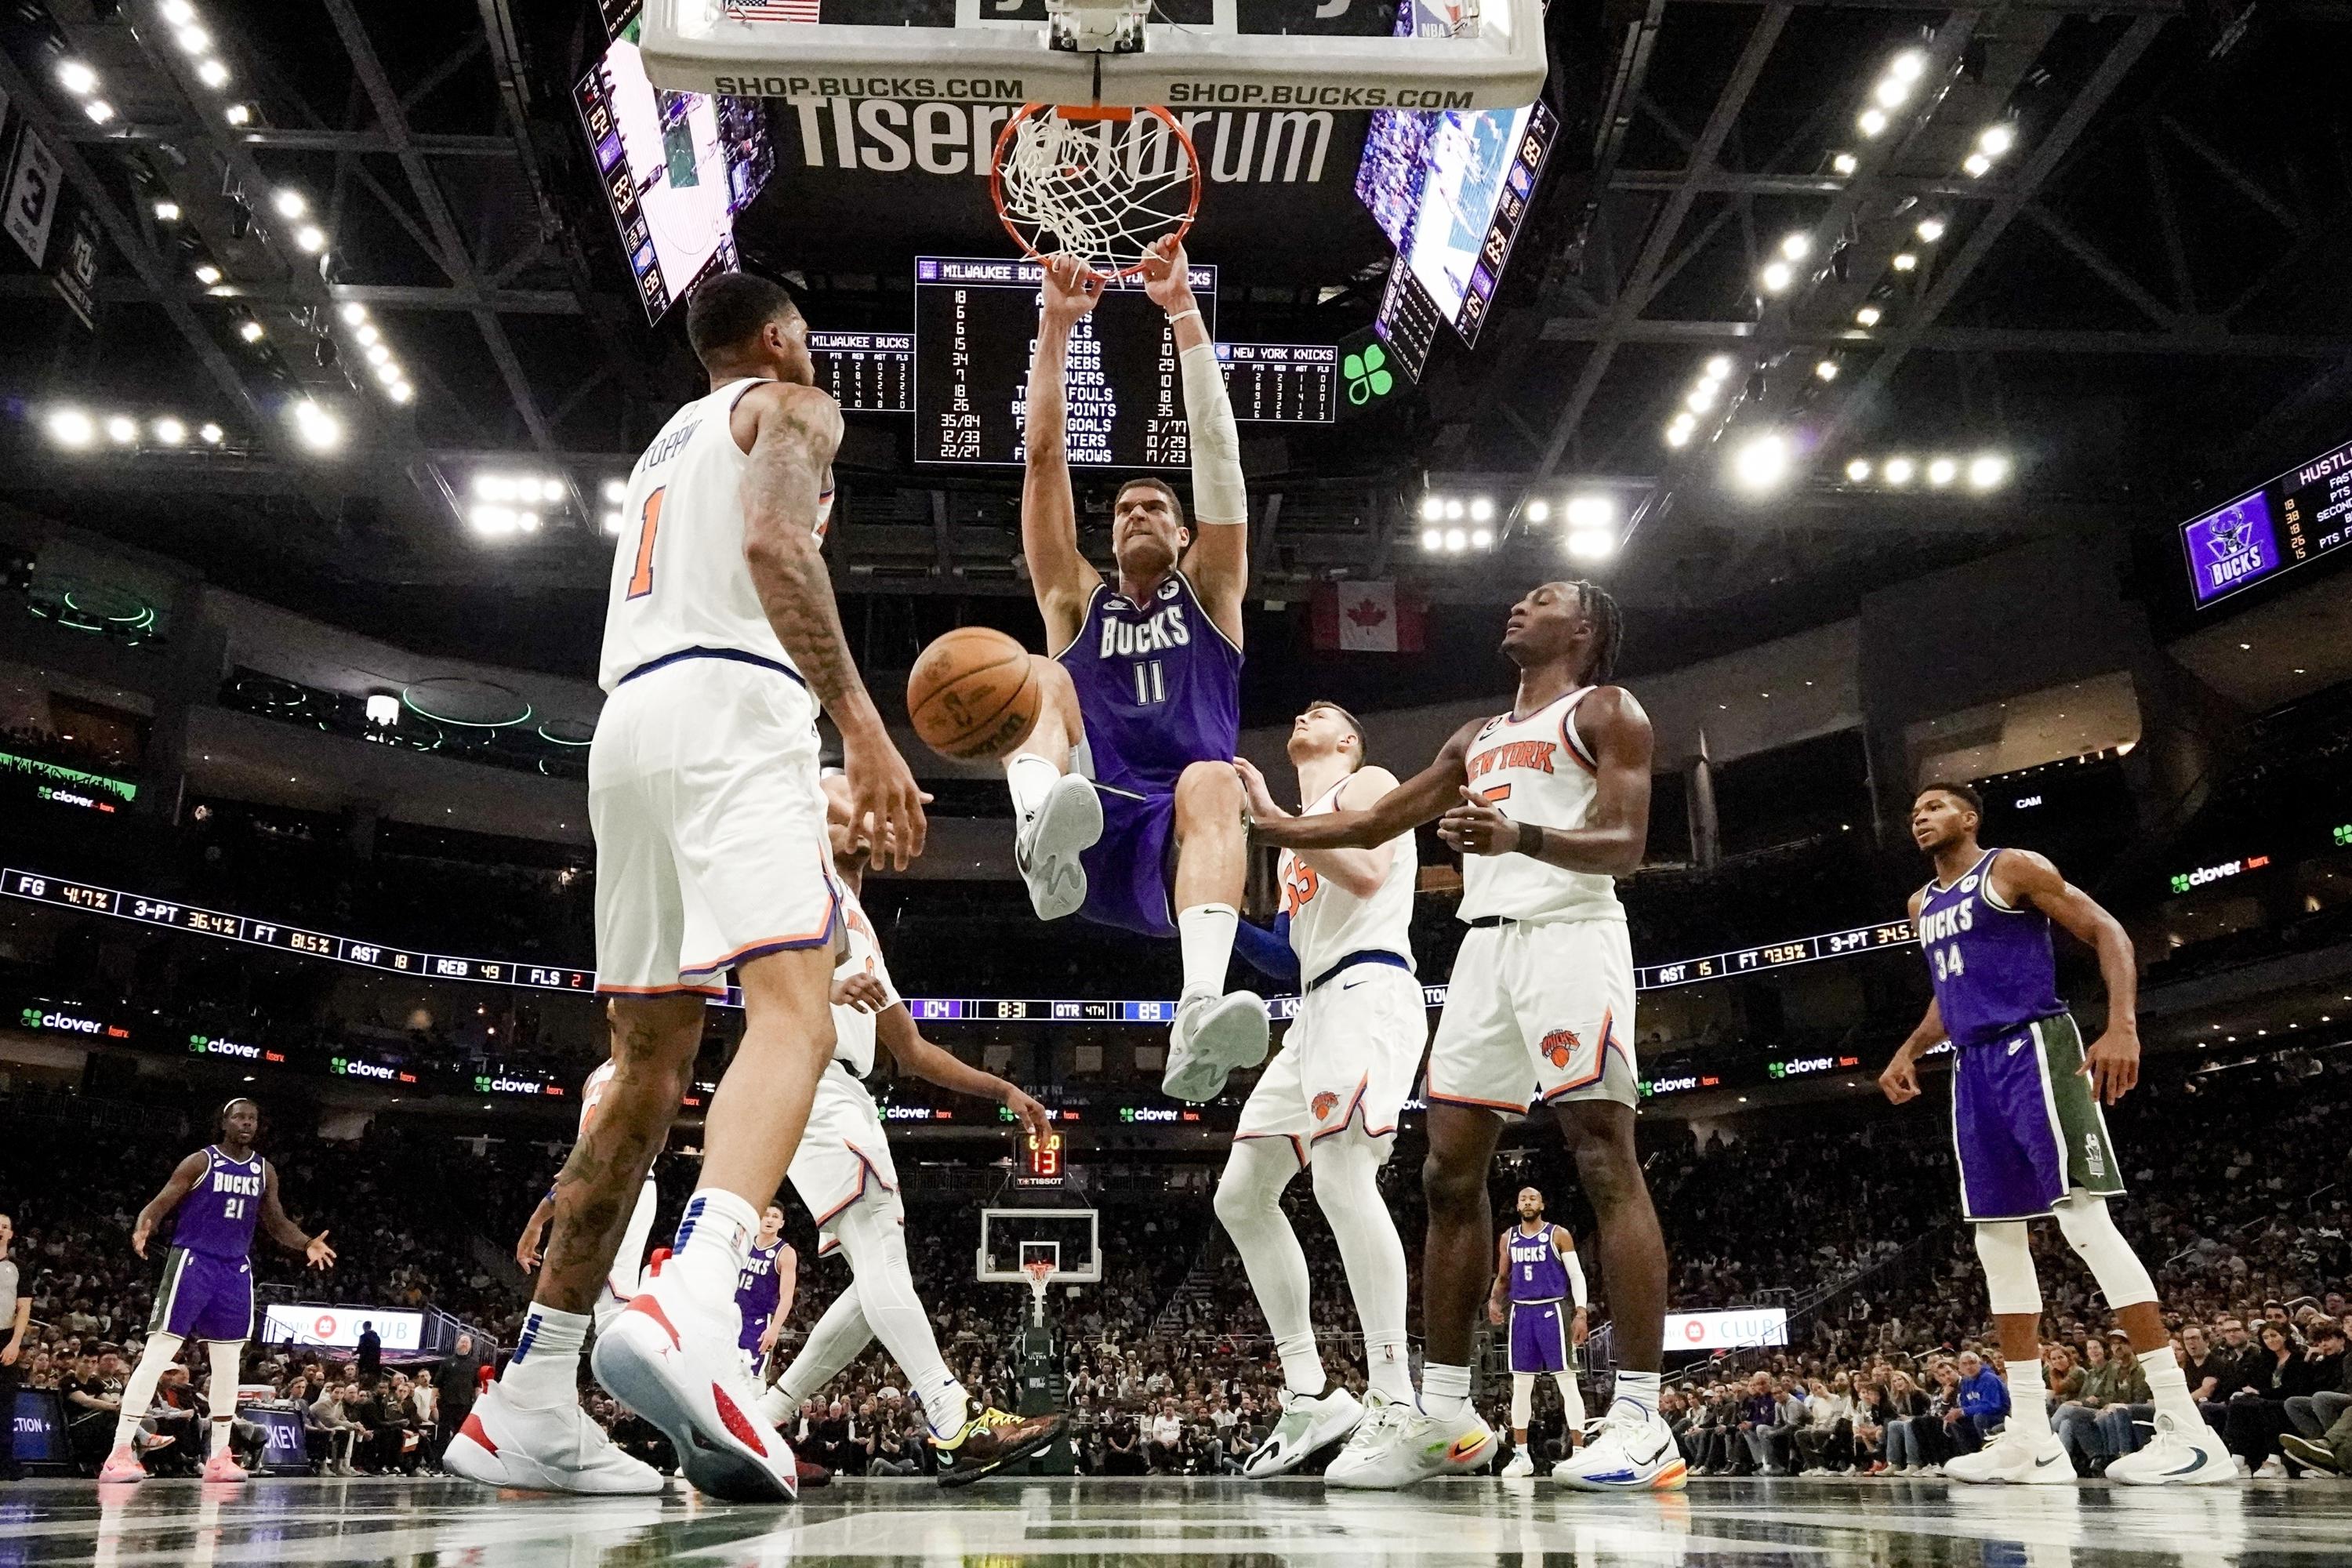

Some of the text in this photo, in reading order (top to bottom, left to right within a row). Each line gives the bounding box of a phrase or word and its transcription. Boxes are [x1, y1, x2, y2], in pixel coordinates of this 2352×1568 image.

[1421, 24, 1446, 37] NBA
[716, 77, 1023, 99] SHOP.BUCKS.COM
[1169, 82, 1473, 109] SHOP.BUCKS.COM
[590, 105, 611, 140] 104
[1523, 136, 1541, 167] 89
[612, 173, 634, 214] 8:31
[1486, 226, 1508, 265] 8:31
[943, 264, 1011, 280] MILWAUKEE
[643, 270, 659, 295] 89
[956, 291, 966, 303] 18
[1466, 291, 1483, 320] 104
[957, 306, 964, 318] 6
[956, 322, 964, 334] 6
[1164, 328, 1171, 340] 6
[811, 336, 909, 348] MILWAUKEE BUCKS
[956, 337, 965, 350] 15
[1162, 343, 1172, 356] 10
[953, 353, 967, 365] 34
[1233, 347, 1334, 361] NEW YORK KNICKS
[1159, 359, 1174, 372] 29
[956, 369, 964, 381] 7
[1161, 375, 1171, 387] 10
[955, 385, 1112, 401] 18 FOULS
[1161, 390, 1171, 402] 18
[954, 399, 1116, 416] 26 POINTS
[1158, 401, 1173, 416] 35
[942, 414, 1112, 432] 35/84 GOALS
[941, 445, 979, 458] 22/27
[2285, 486, 2350, 510] 18 PTS
[2286, 510, 2299, 524] 38
[625, 485, 666, 601] 1
[2291, 533, 2339, 549] 26 PTS
[2296, 549, 2306, 559] 15
[2211, 545, 2262, 586] BUCKS
[1099, 604, 1191, 659] BUCKS
[1133, 659, 1167, 706] 11
[1499, 741, 1556, 775] YORK
[52, 790, 93, 808] clover
[2016, 796, 2042, 808] CAM
[2189, 861, 2241, 886] clover
[18, 877, 108, 910] FG 41.7%
[133, 900, 236, 935] 3-PT 36.4%
[1919, 896, 1975, 949] BUCKS
[254, 924, 330, 953] FT 81.5%
[1830, 931, 1869, 953] 3-PT
[350, 944, 407, 968] AST 18
[1738, 944, 1806, 969] FT 73.9%
[1934, 942, 1965, 982] 34
[436, 959, 499, 978] REB 49
[1659, 962, 1713, 984] AST 15
[530, 969, 580, 987] FLS 2
[924, 1000, 950, 1018] 104
[998, 1002, 1025, 1018] 8:31
[1055, 1004, 1105, 1017] QTR 4TH
[1139, 1003, 1160, 1019] 89
[42, 1012, 101, 1033] clover
[208, 1038, 260, 1058] clover
[347, 1060, 394, 1079] clover
[1785, 1058, 1832, 1074] clover
[491, 1078, 540, 1094] clover
[1653, 1077, 1696, 1093] clover
[887, 1105, 930, 1119] clover
[1134, 1107, 1178, 1121] clover
[1035, 1150, 1055, 1174] 13
[213, 1171, 260, 1196] BUCKS
[223, 1197, 245, 1220] 21
[1511, 1244, 1547, 1263] BUCKS
[739, 1272, 753, 1291] 12
[1523, 1265, 1533, 1281] 5
[353, 1319, 407, 1339] CUB
[1721, 1319, 1774, 1338] CLUB
